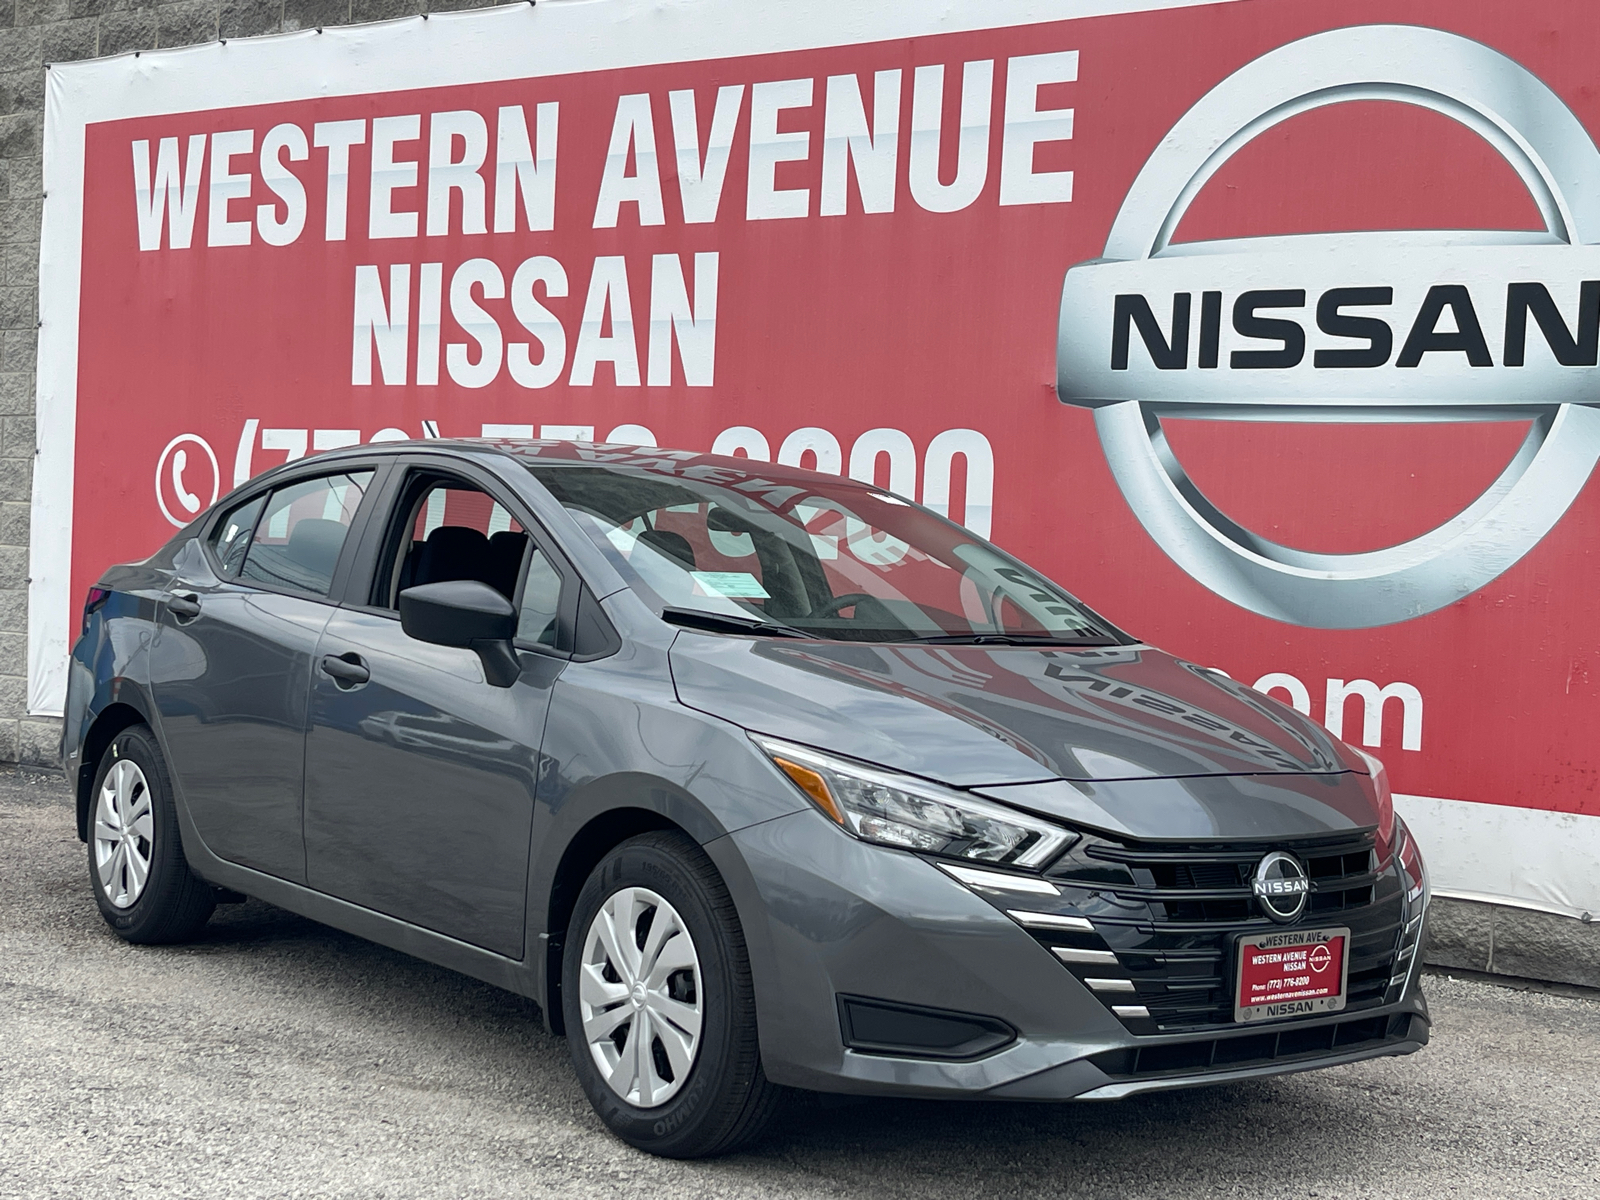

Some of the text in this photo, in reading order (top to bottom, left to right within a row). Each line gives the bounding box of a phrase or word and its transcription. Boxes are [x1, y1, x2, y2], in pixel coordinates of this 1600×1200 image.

[131, 50, 1080, 252] WESTERN AVENUE
[351, 251, 720, 389] NISSAN
[1110, 280, 1600, 371] NISSAN
[1255, 880, 1309, 893] NISSAN
[1266, 934, 1305, 947] WESTERN
[1252, 951, 1308, 965] WESTERN AVENUE
[1283, 961, 1307, 972] NISSAN
[1267, 979, 1283, 991] (773)
[1283, 976, 1310, 988] 776-8200
[1267, 1001, 1314, 1016] NISSAN
[653, 1075, 707, 1137] KUMHO
